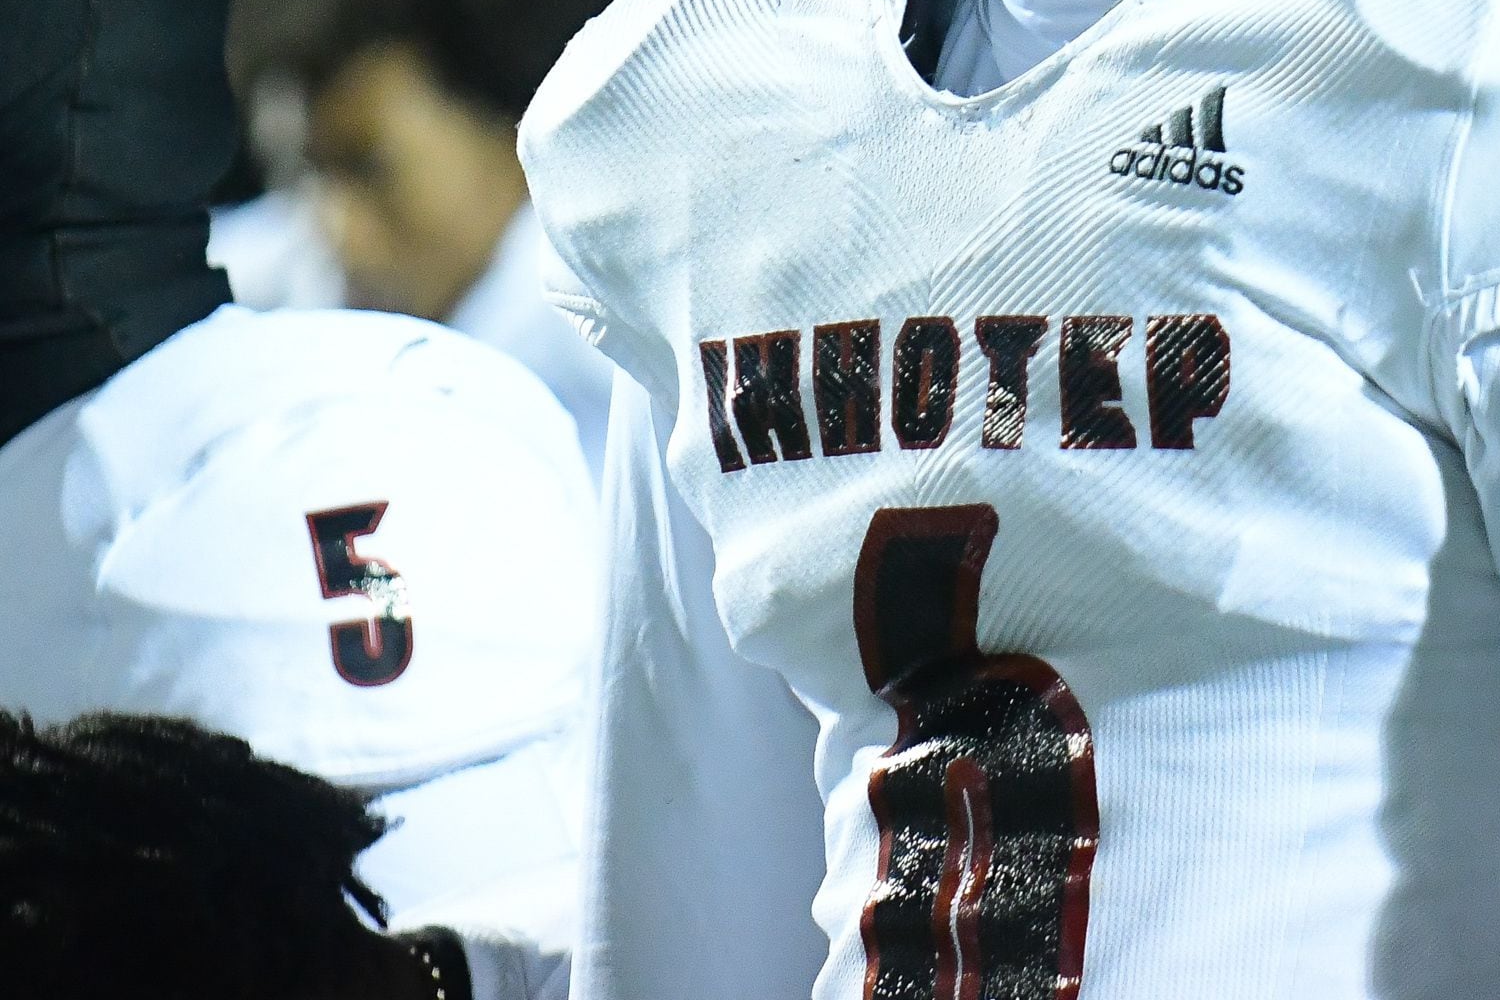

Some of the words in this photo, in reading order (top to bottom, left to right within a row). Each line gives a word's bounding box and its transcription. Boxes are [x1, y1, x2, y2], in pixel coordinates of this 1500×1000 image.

[1109, 144, 1246, 196] adidas
[699, 314, 1231, 473] IMHOTEP
[305, 500, 414, 687] 5
[854, 503, 1099, 1000] 6
